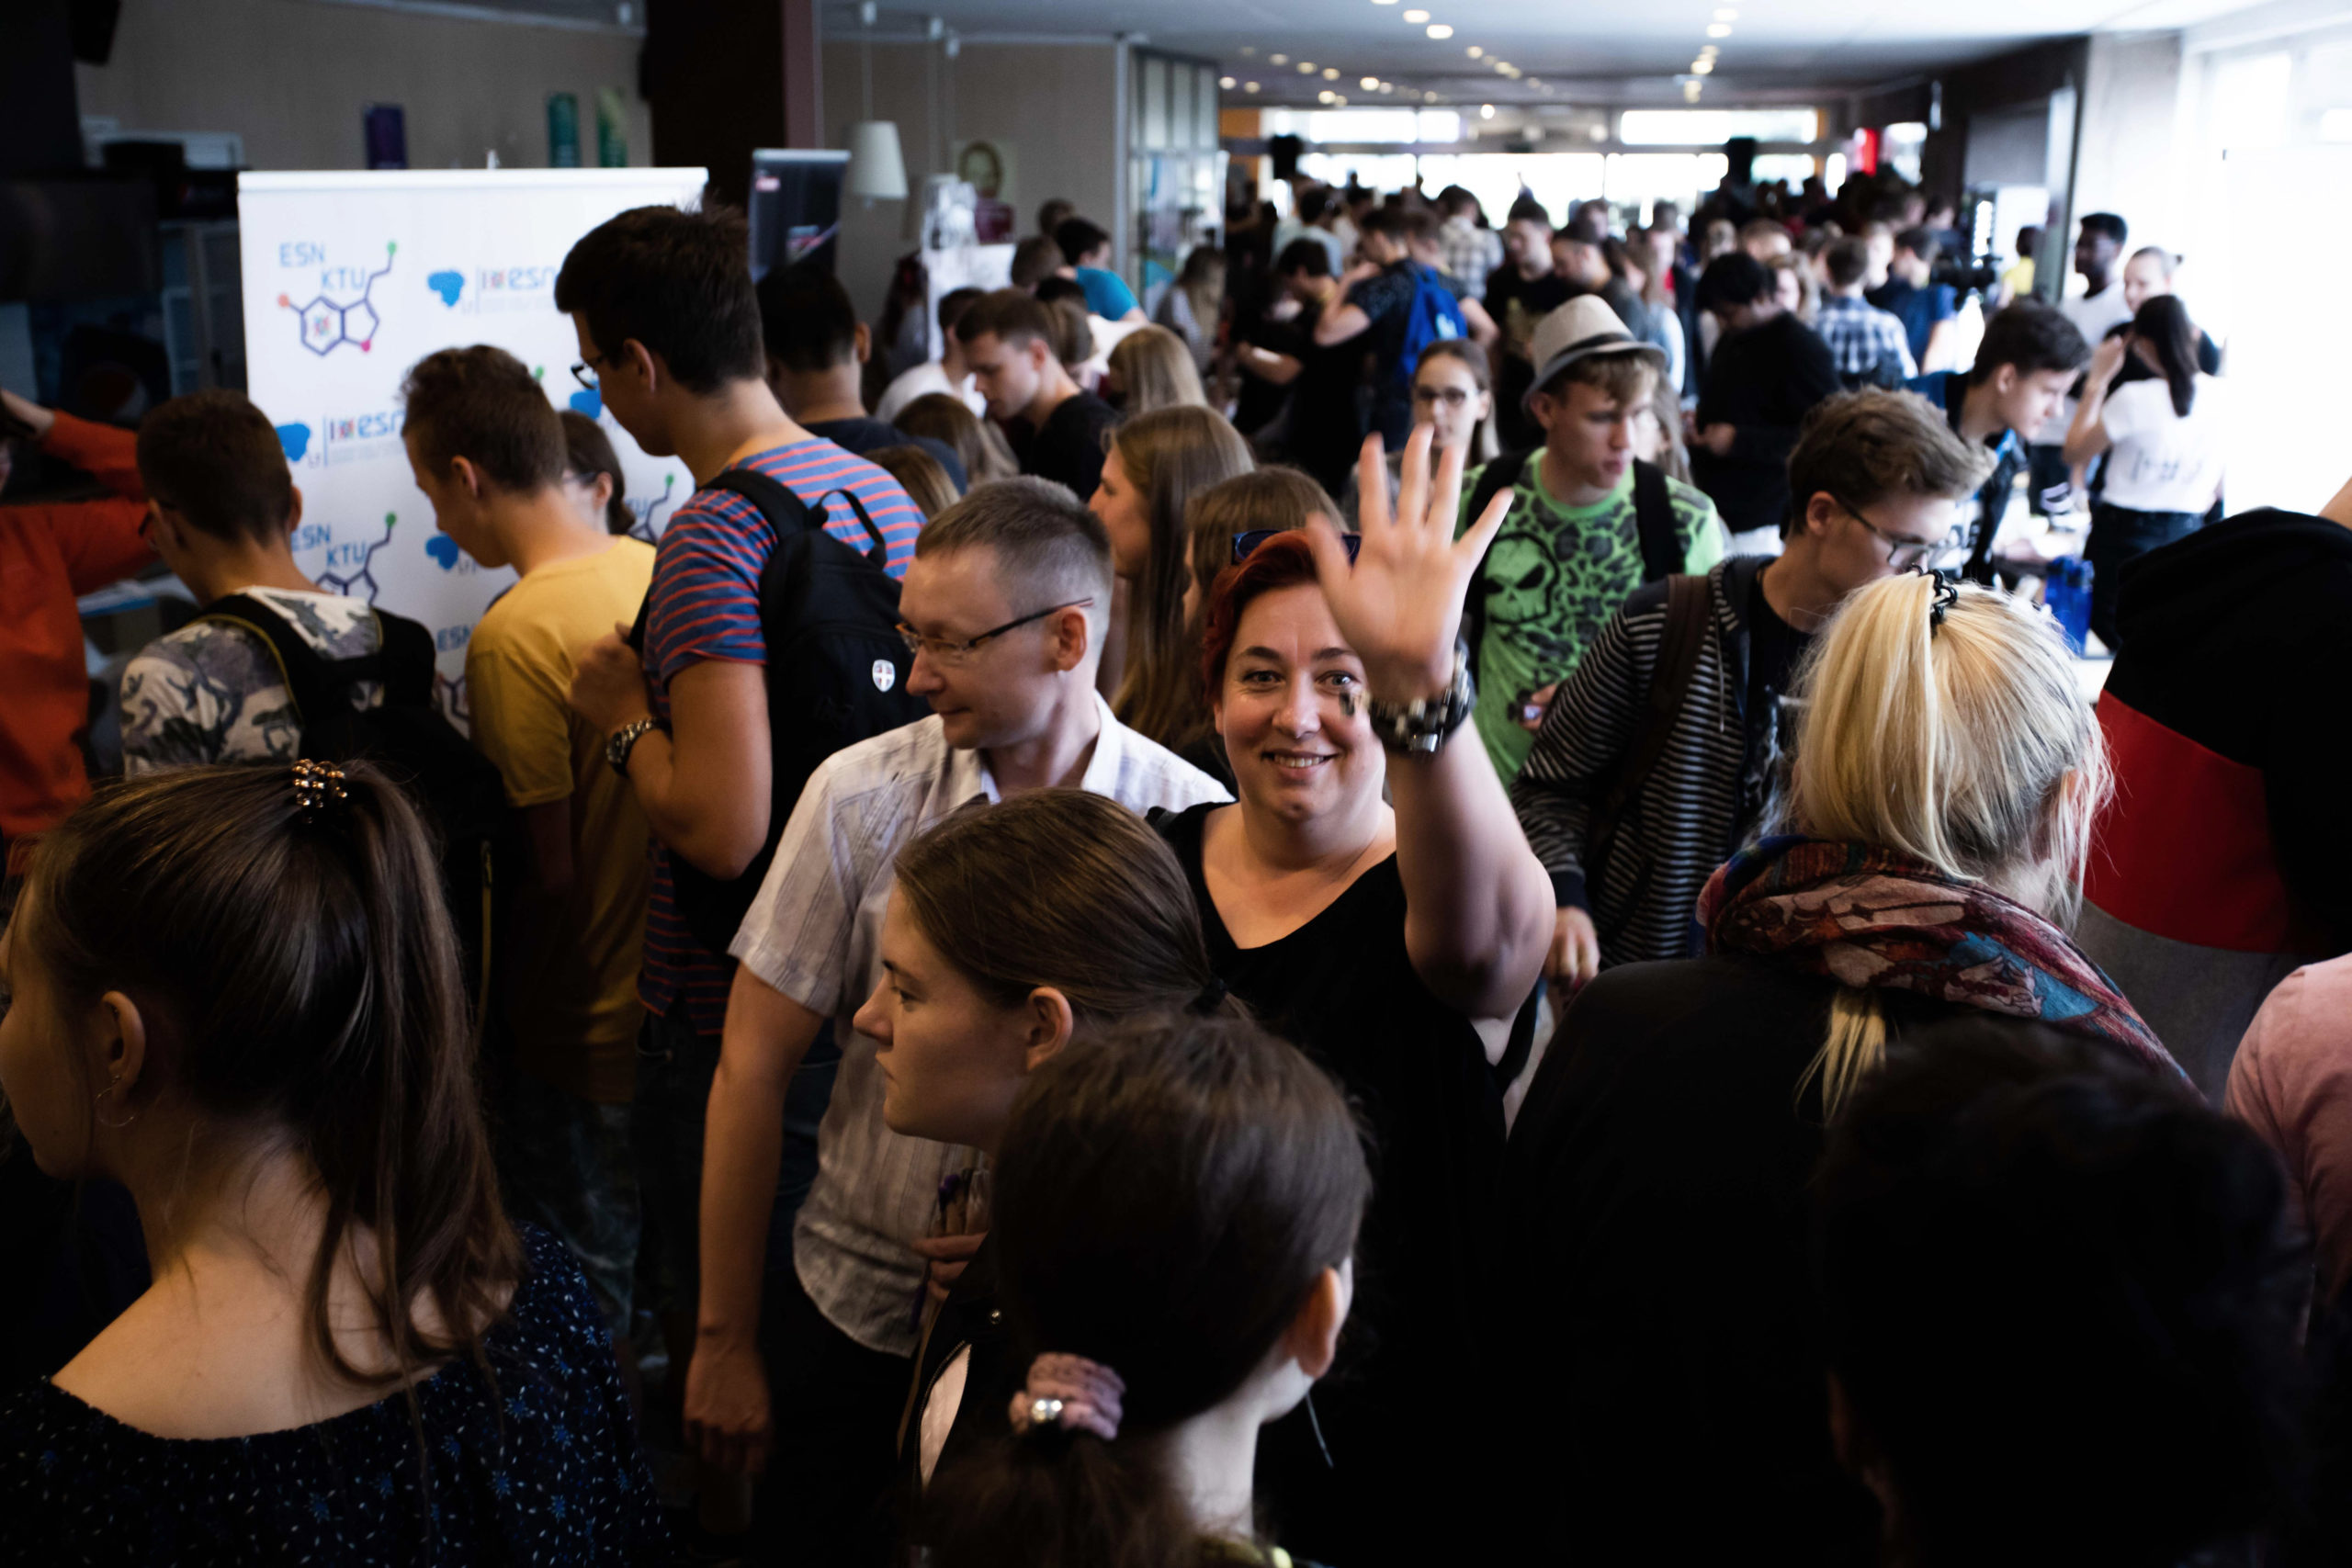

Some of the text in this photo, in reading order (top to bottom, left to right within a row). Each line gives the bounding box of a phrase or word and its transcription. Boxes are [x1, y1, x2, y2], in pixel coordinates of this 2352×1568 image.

[279, 242, 324, 267] ESN
[322, 266, 365, 290] KTU
[326, 540, 366, 566] KTU
